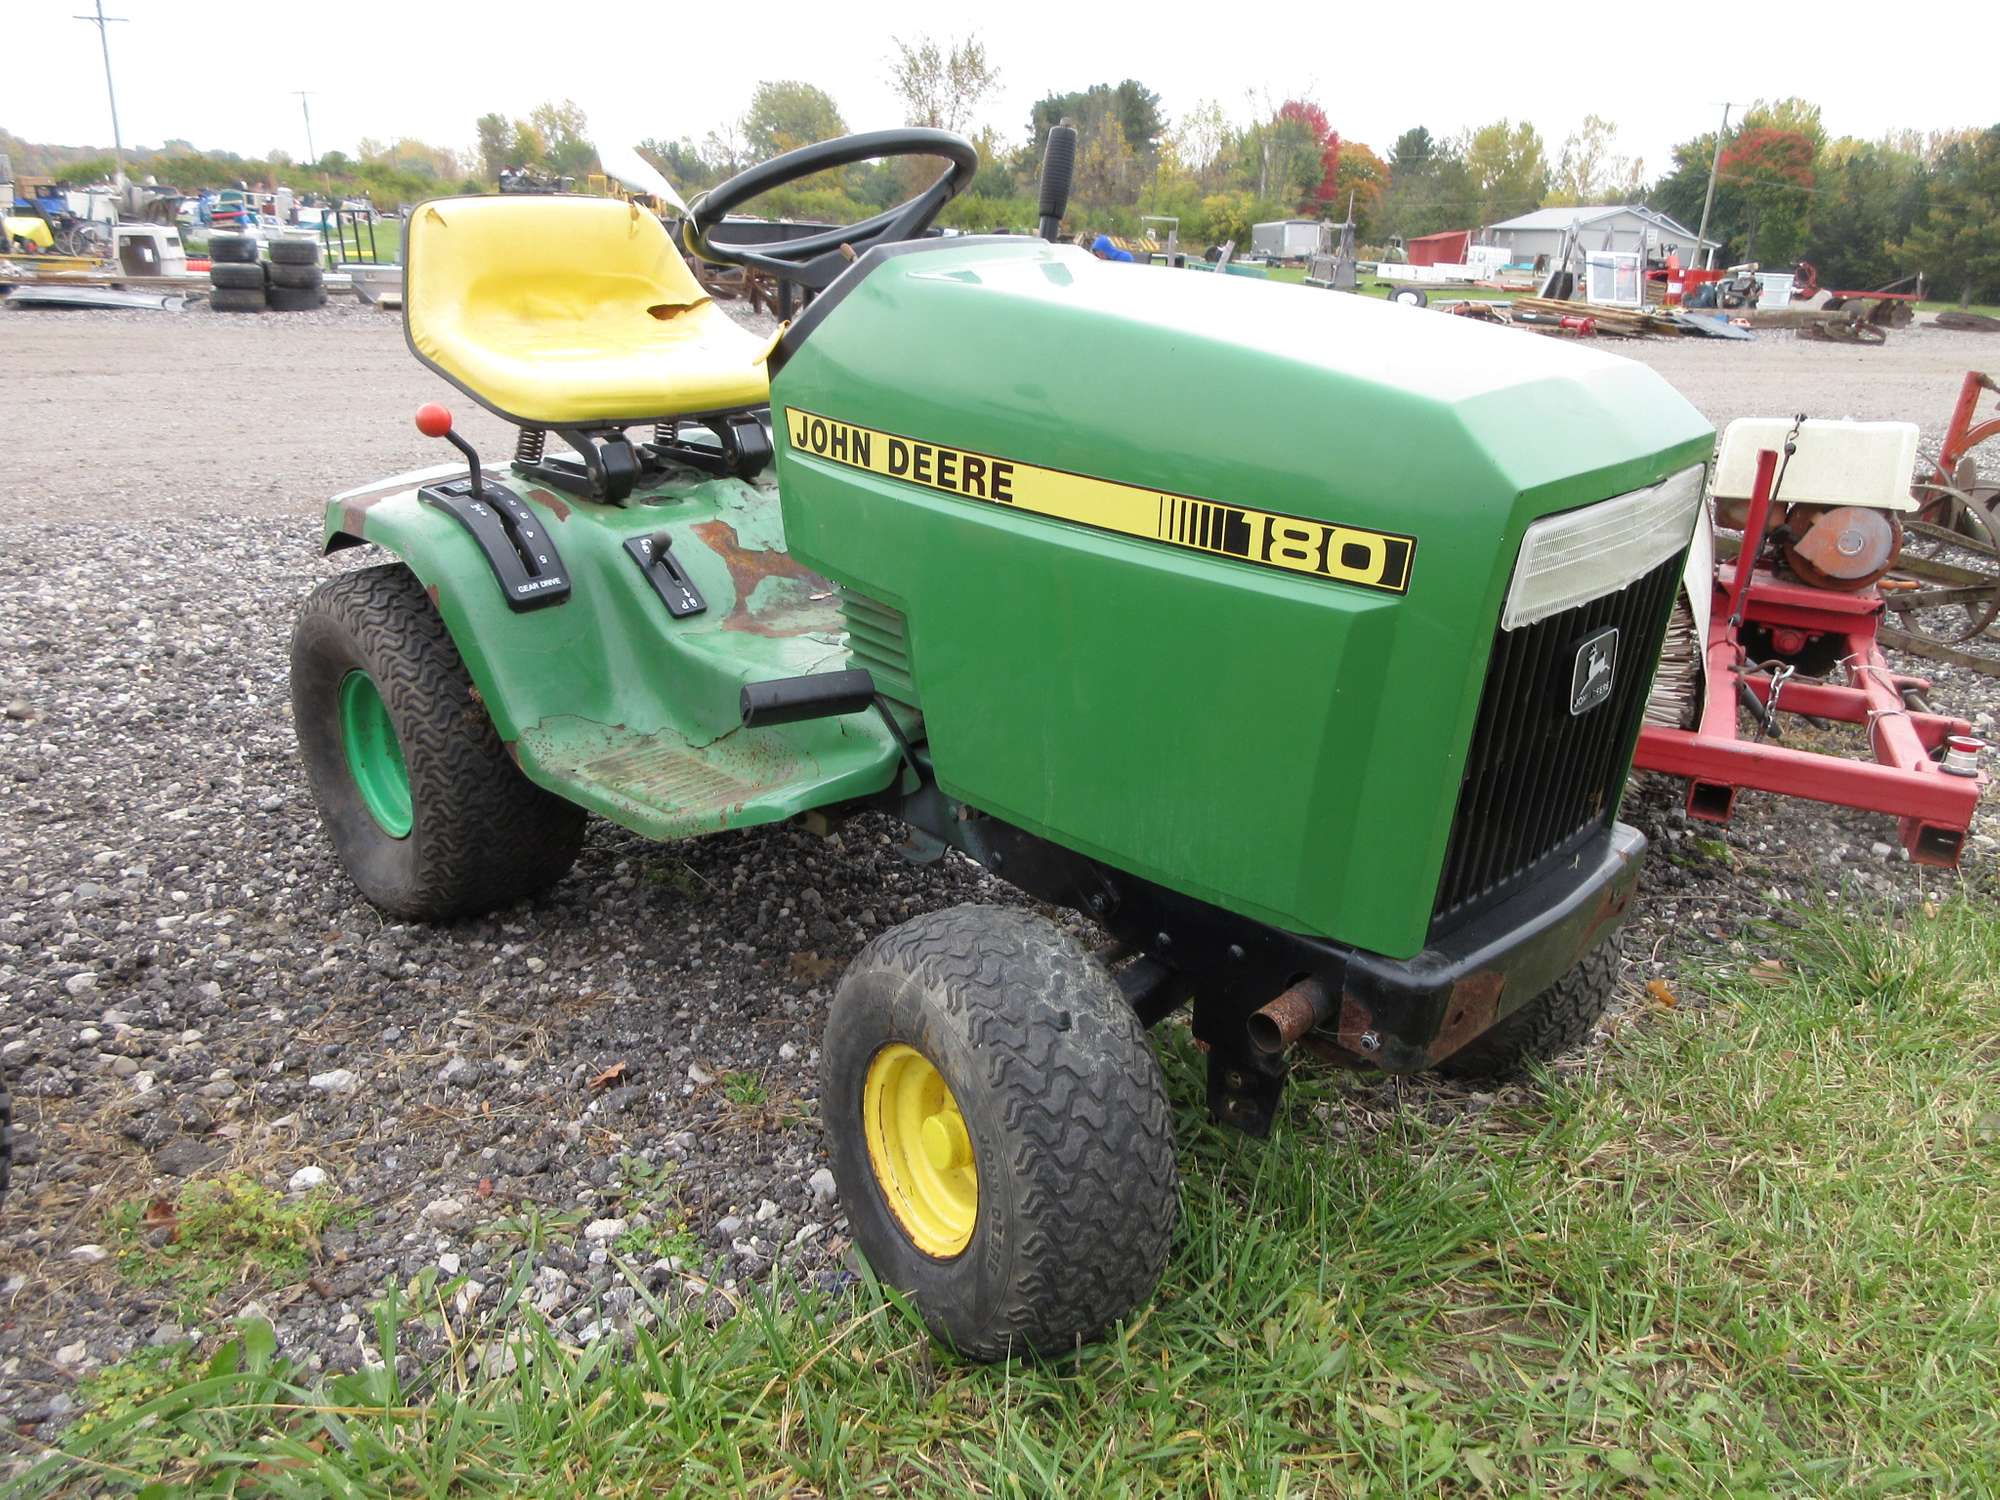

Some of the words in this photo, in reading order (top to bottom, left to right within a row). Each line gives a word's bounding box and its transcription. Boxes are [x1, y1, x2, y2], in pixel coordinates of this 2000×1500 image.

[796, 415, 871, 468] JOHN
[888, 438, 1014, 503] DEERE
[1241, 509, 1387, 585] 180
[526, 530, 534, 538] 4
[539, 555, 548, 564] 5
[517, 582, 540, 593] GEAR
[539, 577, 562, 588] DRIVE
